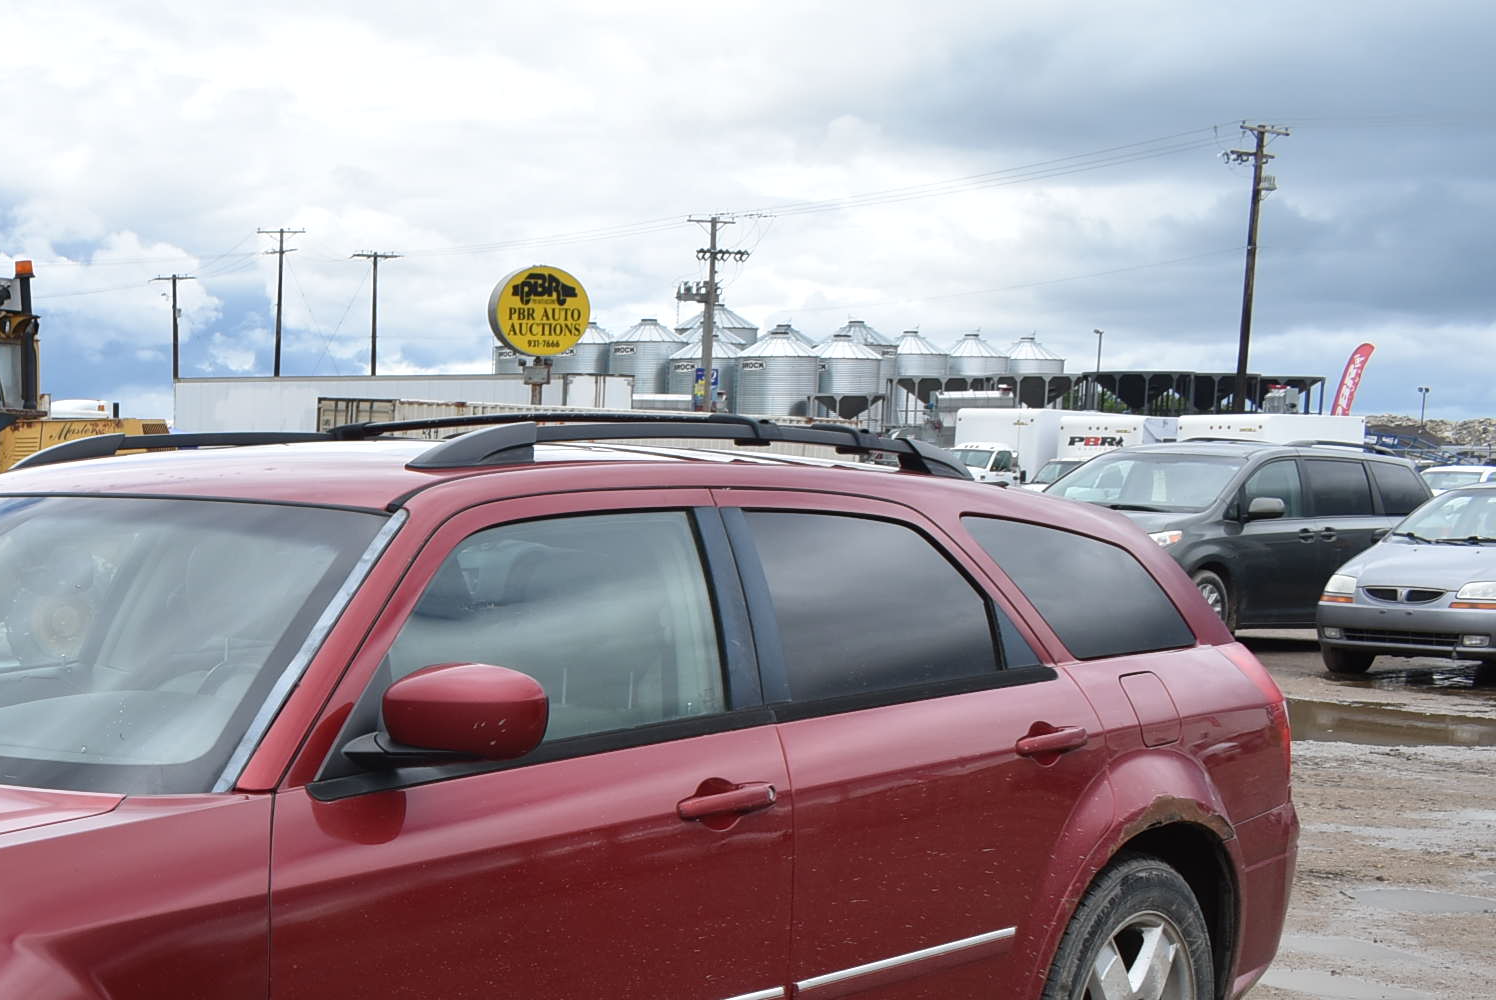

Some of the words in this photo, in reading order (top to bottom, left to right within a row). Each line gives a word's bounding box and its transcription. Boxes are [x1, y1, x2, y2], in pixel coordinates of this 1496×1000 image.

[508, 307, 536, 321] PBR
[540, 308, 582, 322] AUTO
[507, 323, 582, 337] AUCTIONS
[527, 339, 561, 348] 931-7666
[1068, 436, 1117, 447] PBR
